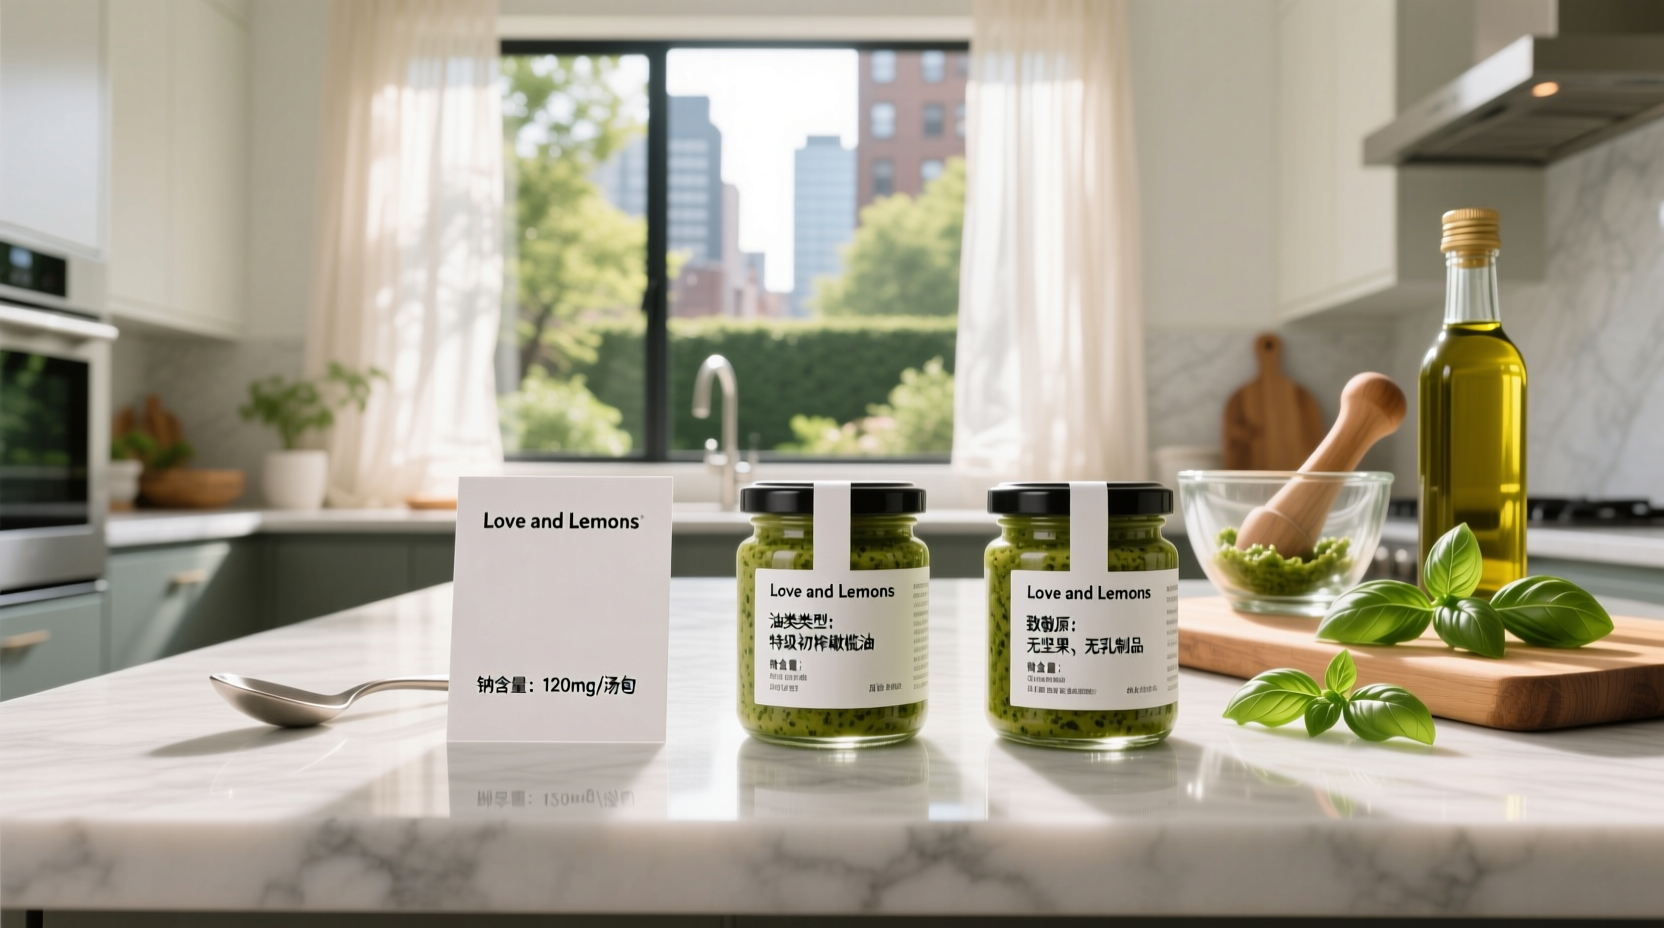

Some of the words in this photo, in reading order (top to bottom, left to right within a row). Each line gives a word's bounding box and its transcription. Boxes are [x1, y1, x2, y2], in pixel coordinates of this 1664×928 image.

[483, 511, 527, 529] Love
[530, 511, 564, 529] and
[569, 512, 640, 530] Lemons
[770, 583, 802, 598] Love
[806, 583, 834, 599] and
[838, 583, 896, 599] Lemons
[1027, 585, 1062, 600] Love
[1065, 585, 1093, 600] and
[1097, 585, 1152, 600] Lemons
